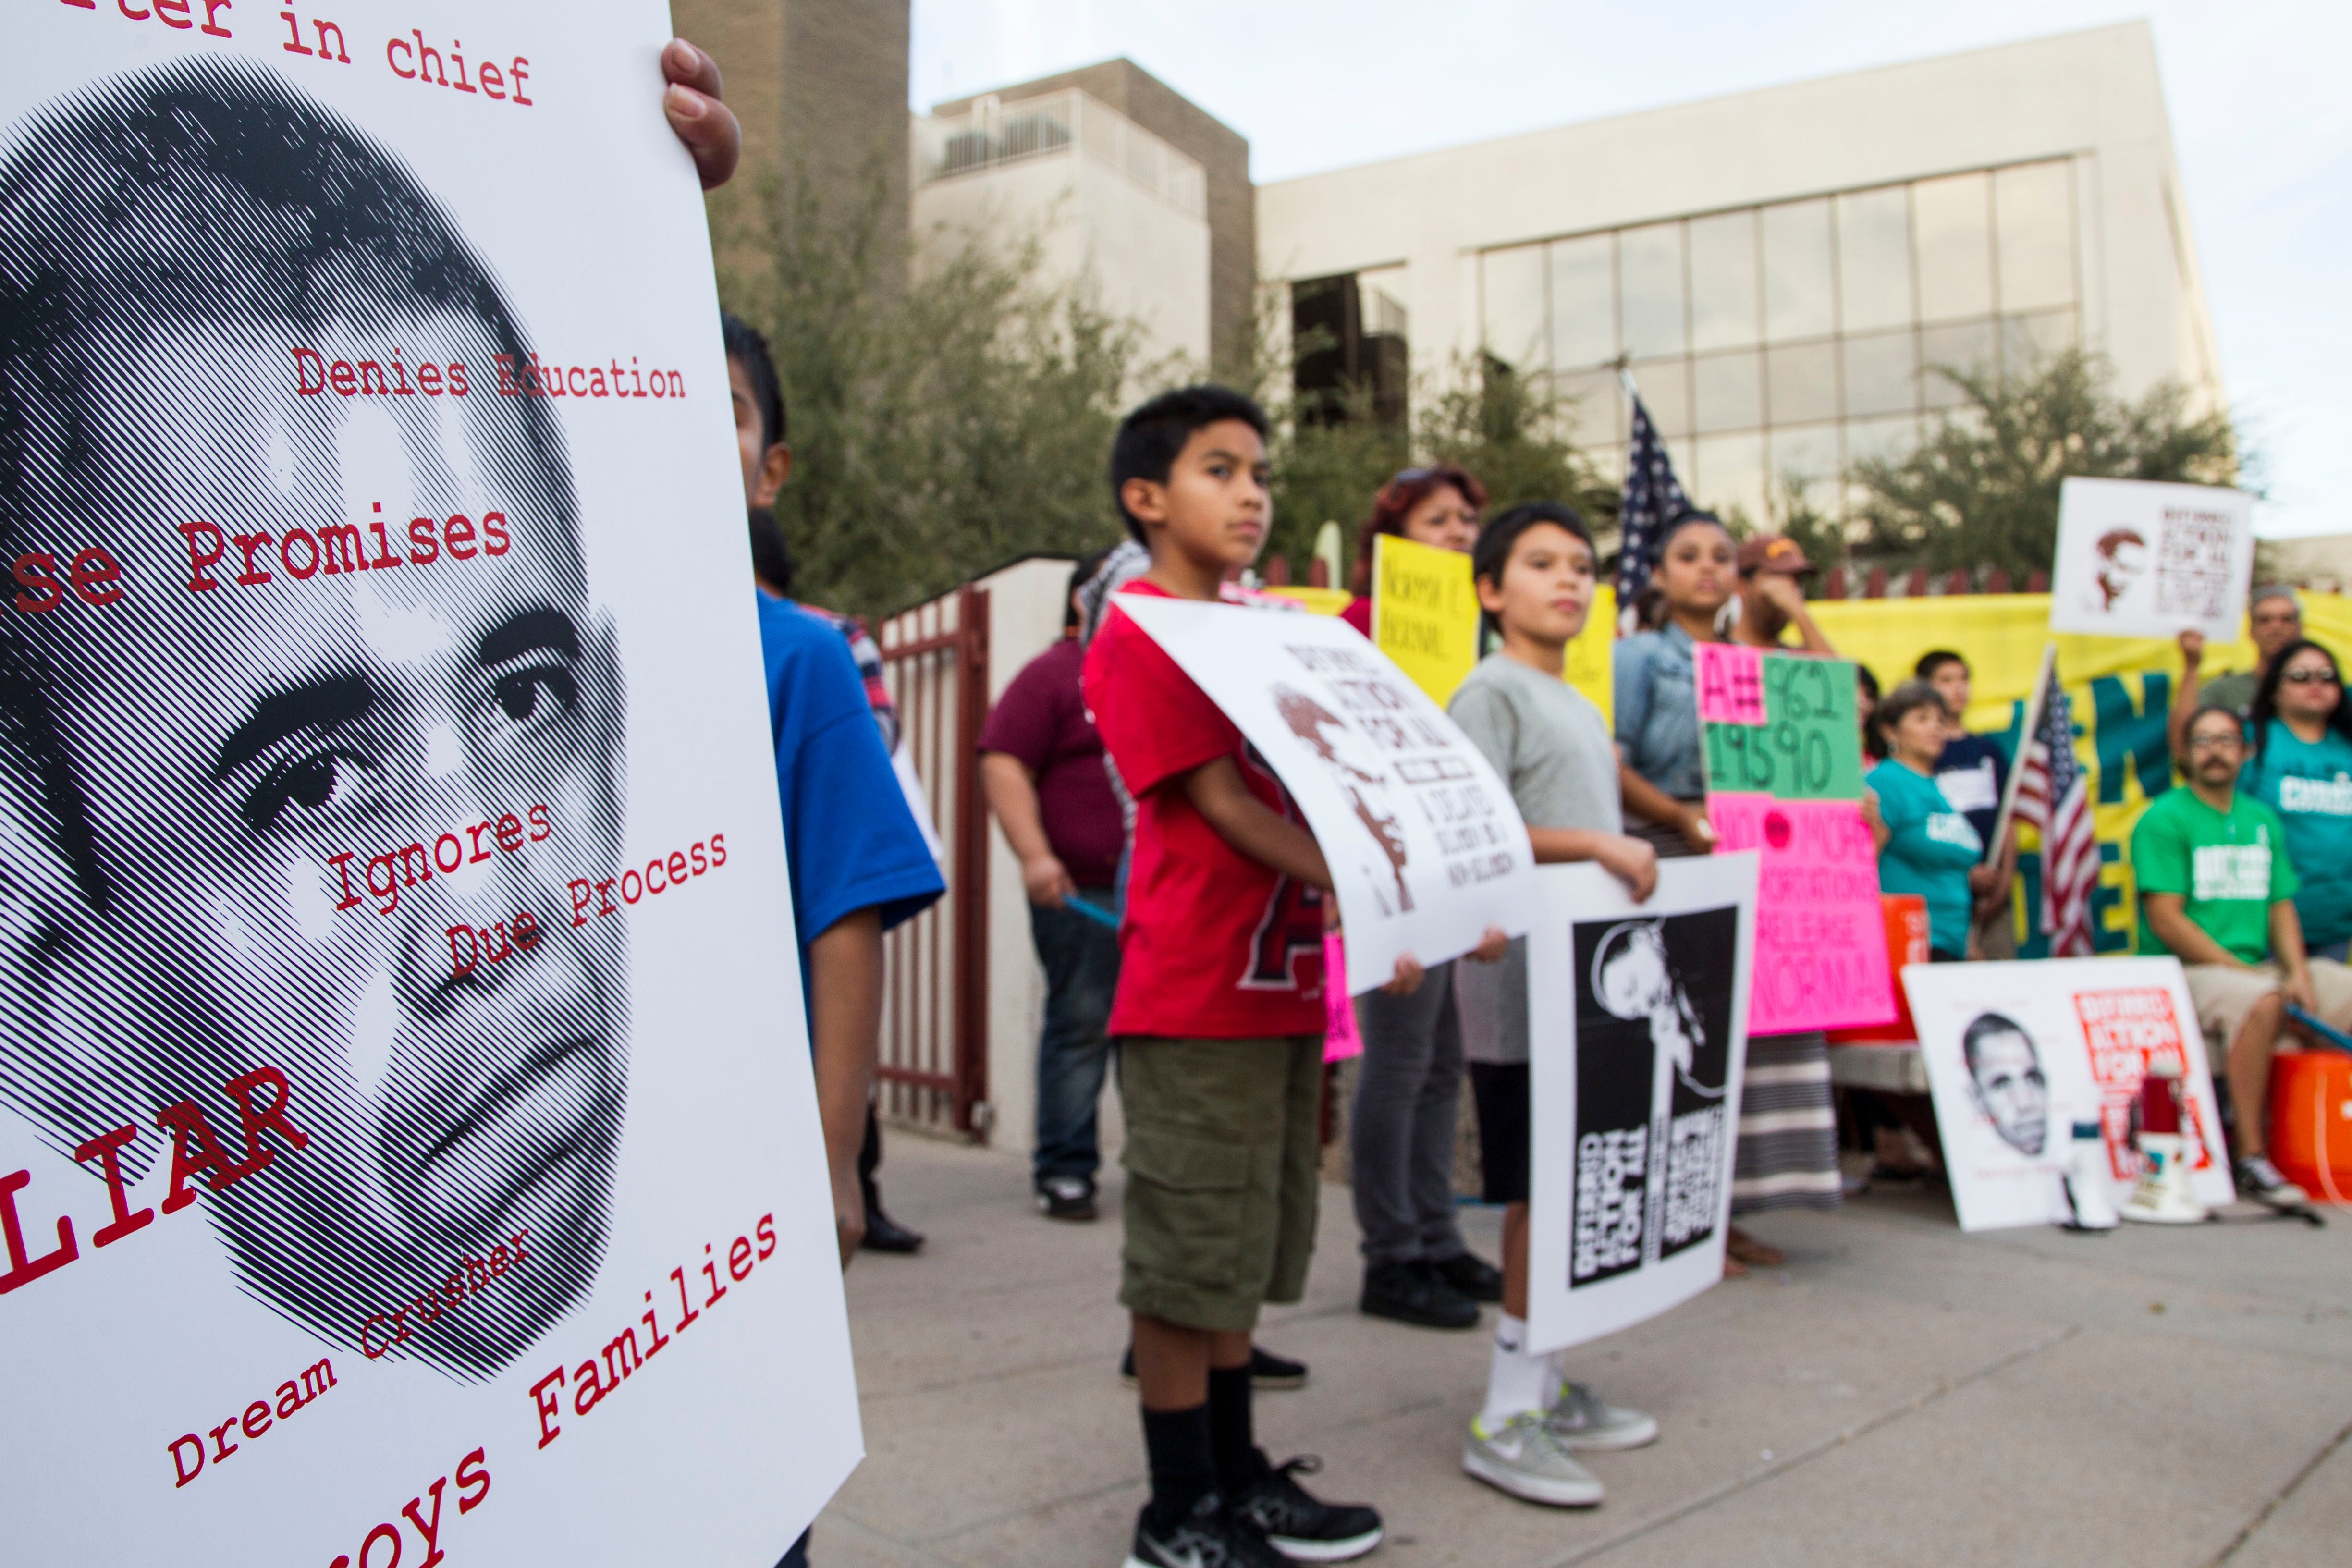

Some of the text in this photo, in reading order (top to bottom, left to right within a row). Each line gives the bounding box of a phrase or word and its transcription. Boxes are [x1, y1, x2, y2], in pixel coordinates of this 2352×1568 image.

[280, 0, 351, 63] in
[386, 29, 533, 106] chief
[291, 347, 686, 399] Denies Education
[0, 501, 511, 613] se Promises
[327, 803, 551, 916] Ignores
[445, 833, 727, 980] Due Process
[0, 1066, 309, 1296] LIAR
[167, 1226, 530, 1489] Dream Crusher
[328, 1213, 777, 1568] oys Families
